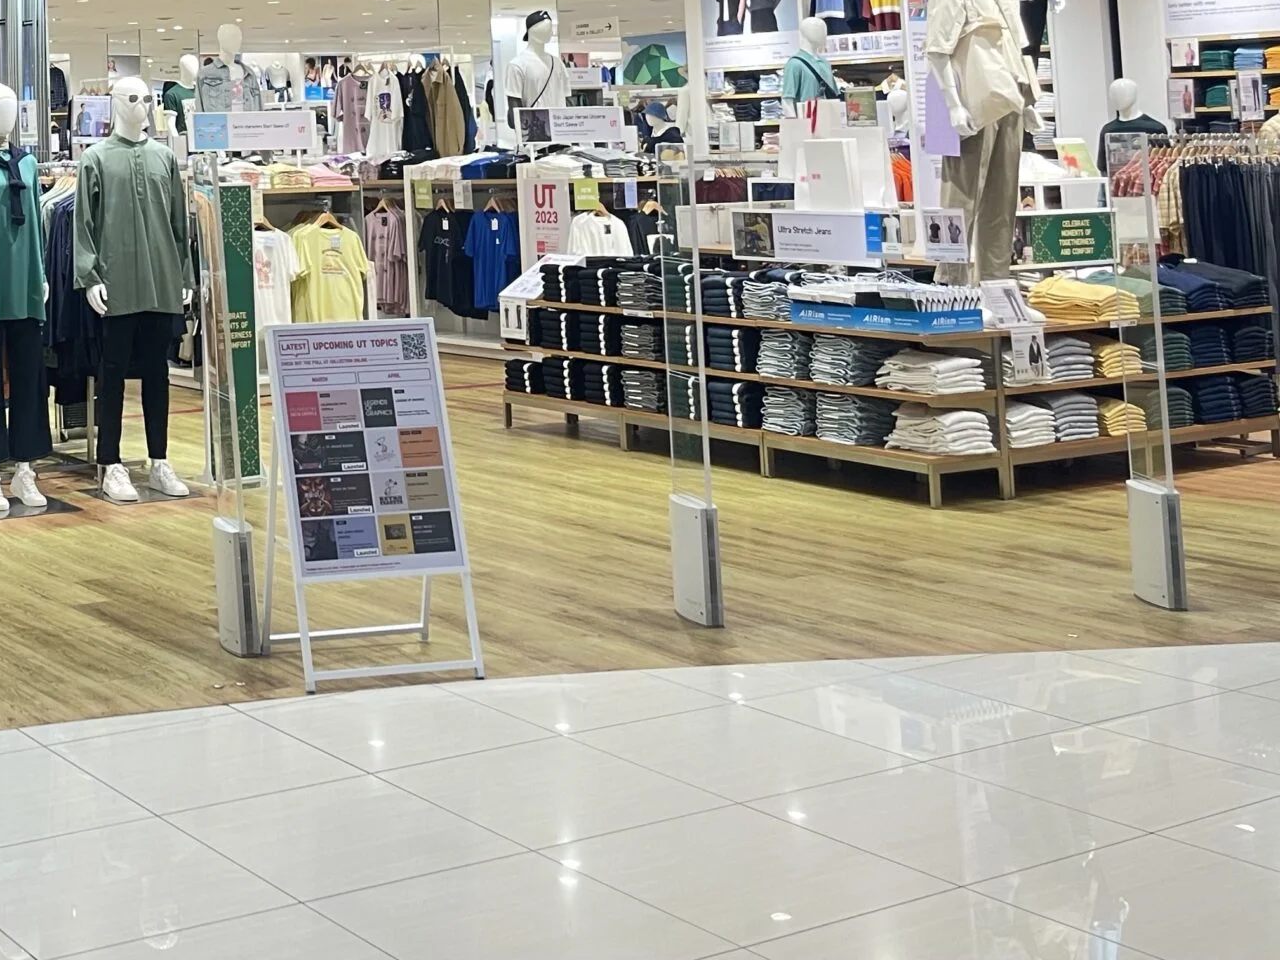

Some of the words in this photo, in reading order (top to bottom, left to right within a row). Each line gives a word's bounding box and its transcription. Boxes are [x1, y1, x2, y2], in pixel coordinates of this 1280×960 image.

[534, 184, 556, 208] UT
[535, 211, 558, 223] 2023
[792, 226, 813, 234] Stretch
[815, 227, 832, 235] Jeans
[799, 310, 825, 318] AIRism
[863, 315, 891, 323] AIRism
[932, 317, 956, 325] AIRism
[281, 343, 307, 351] LATEST
[312, 340, 354, 350] UPCOMING
[356, 340, 367, 348] UT
[370, 338, 399, 347] TOPICS
